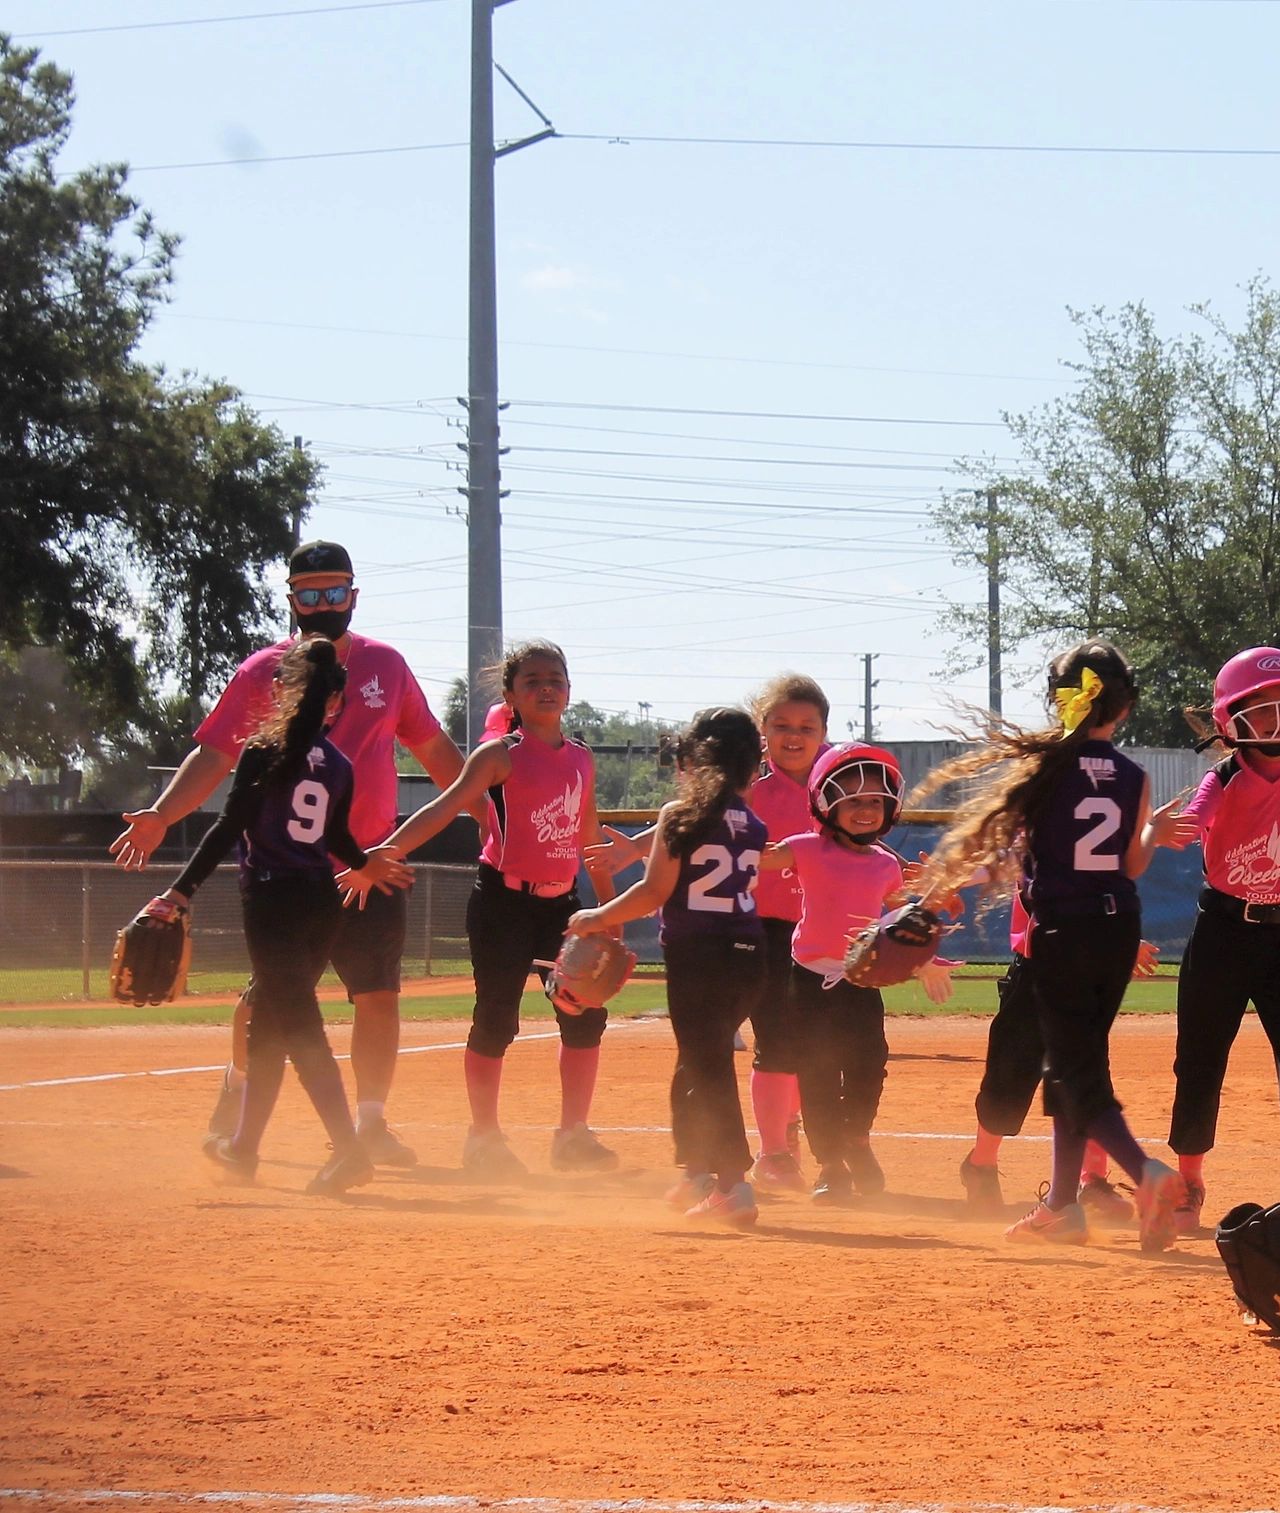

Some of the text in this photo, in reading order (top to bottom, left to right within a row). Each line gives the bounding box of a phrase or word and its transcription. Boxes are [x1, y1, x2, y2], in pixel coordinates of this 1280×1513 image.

[287, 780, 330, 844] 9
[1074, 797, 1121, 871] 2
[687, 844, 760, 913] 23
